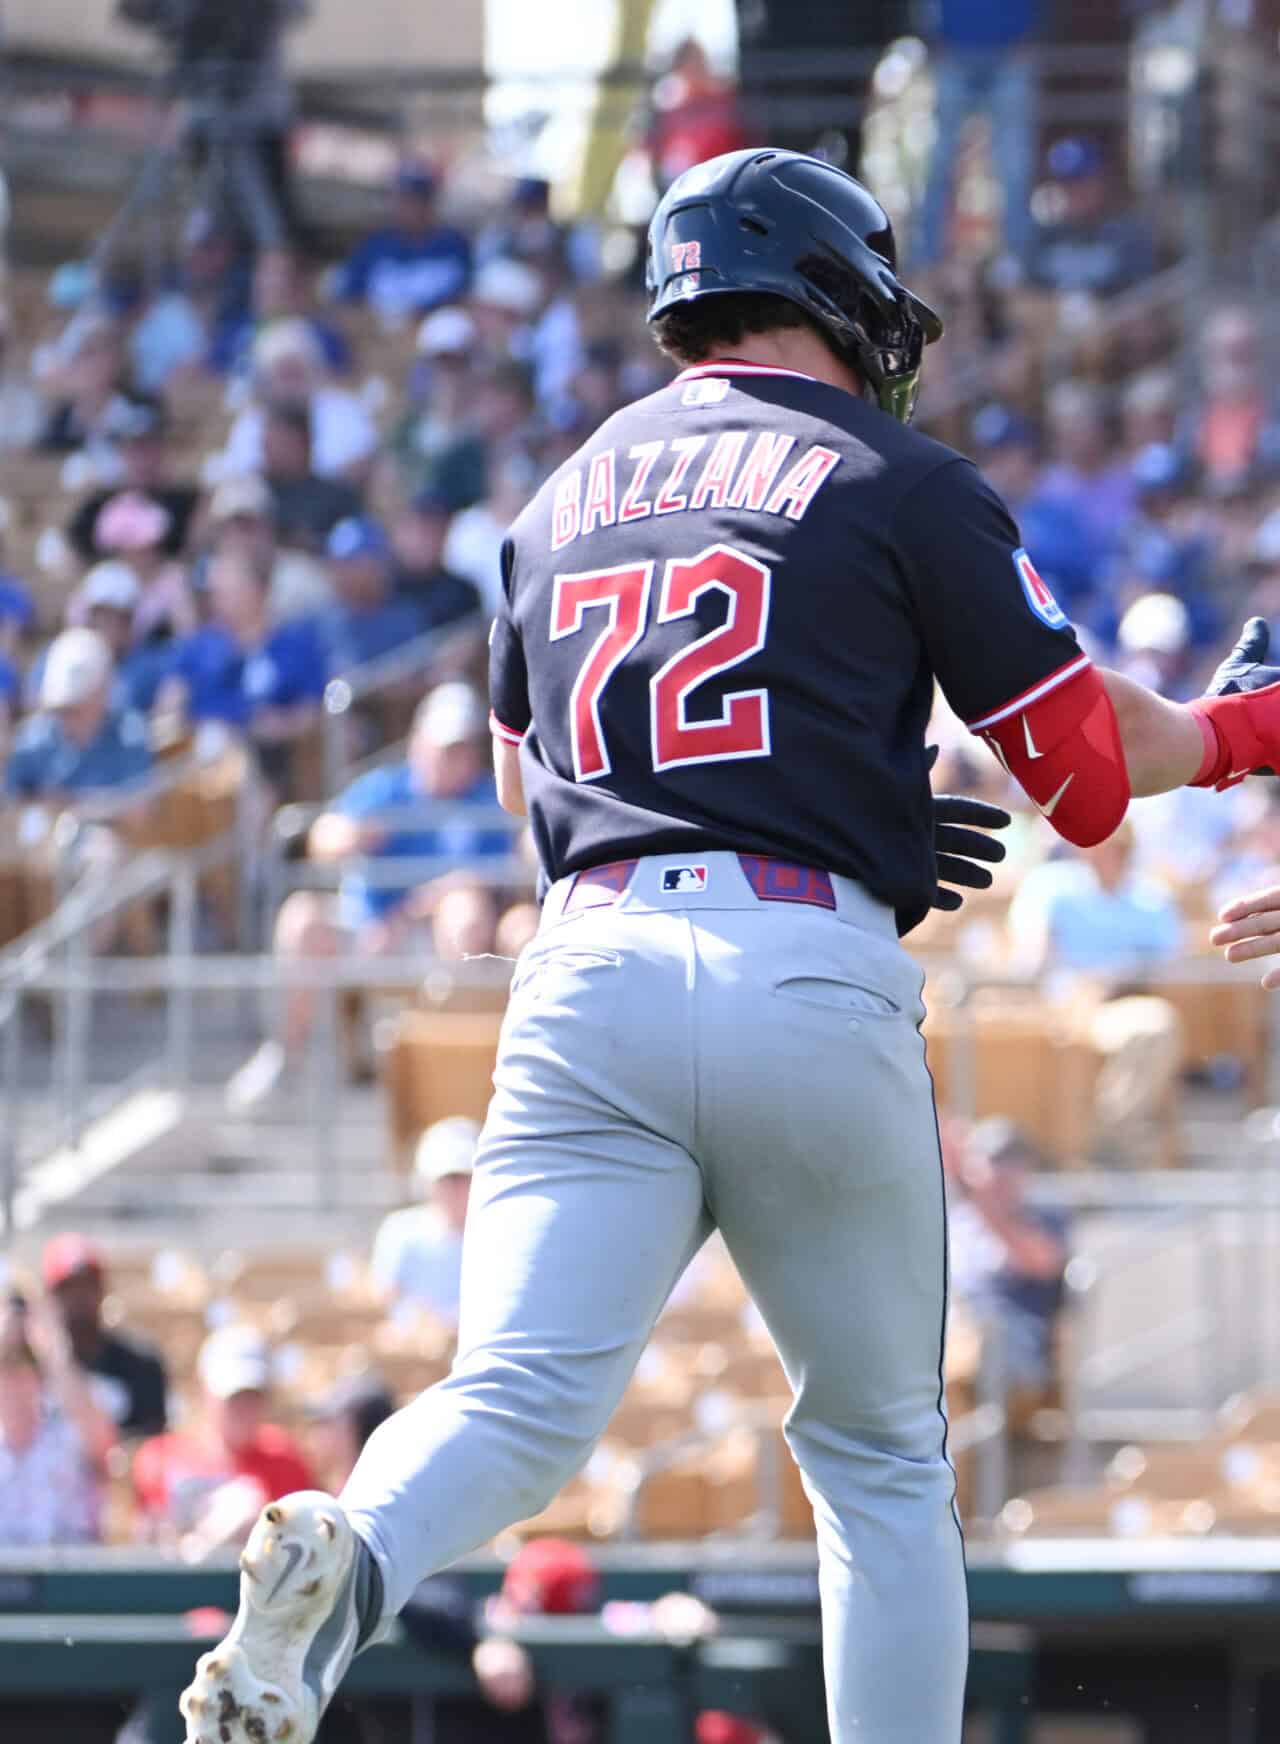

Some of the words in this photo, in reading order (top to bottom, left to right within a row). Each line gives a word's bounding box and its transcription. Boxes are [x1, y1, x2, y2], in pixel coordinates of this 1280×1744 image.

[671, 240, 701, 273] 72
[551, 431, 842, 552] BAZZANA
[549, 543, 772, 783] 72
